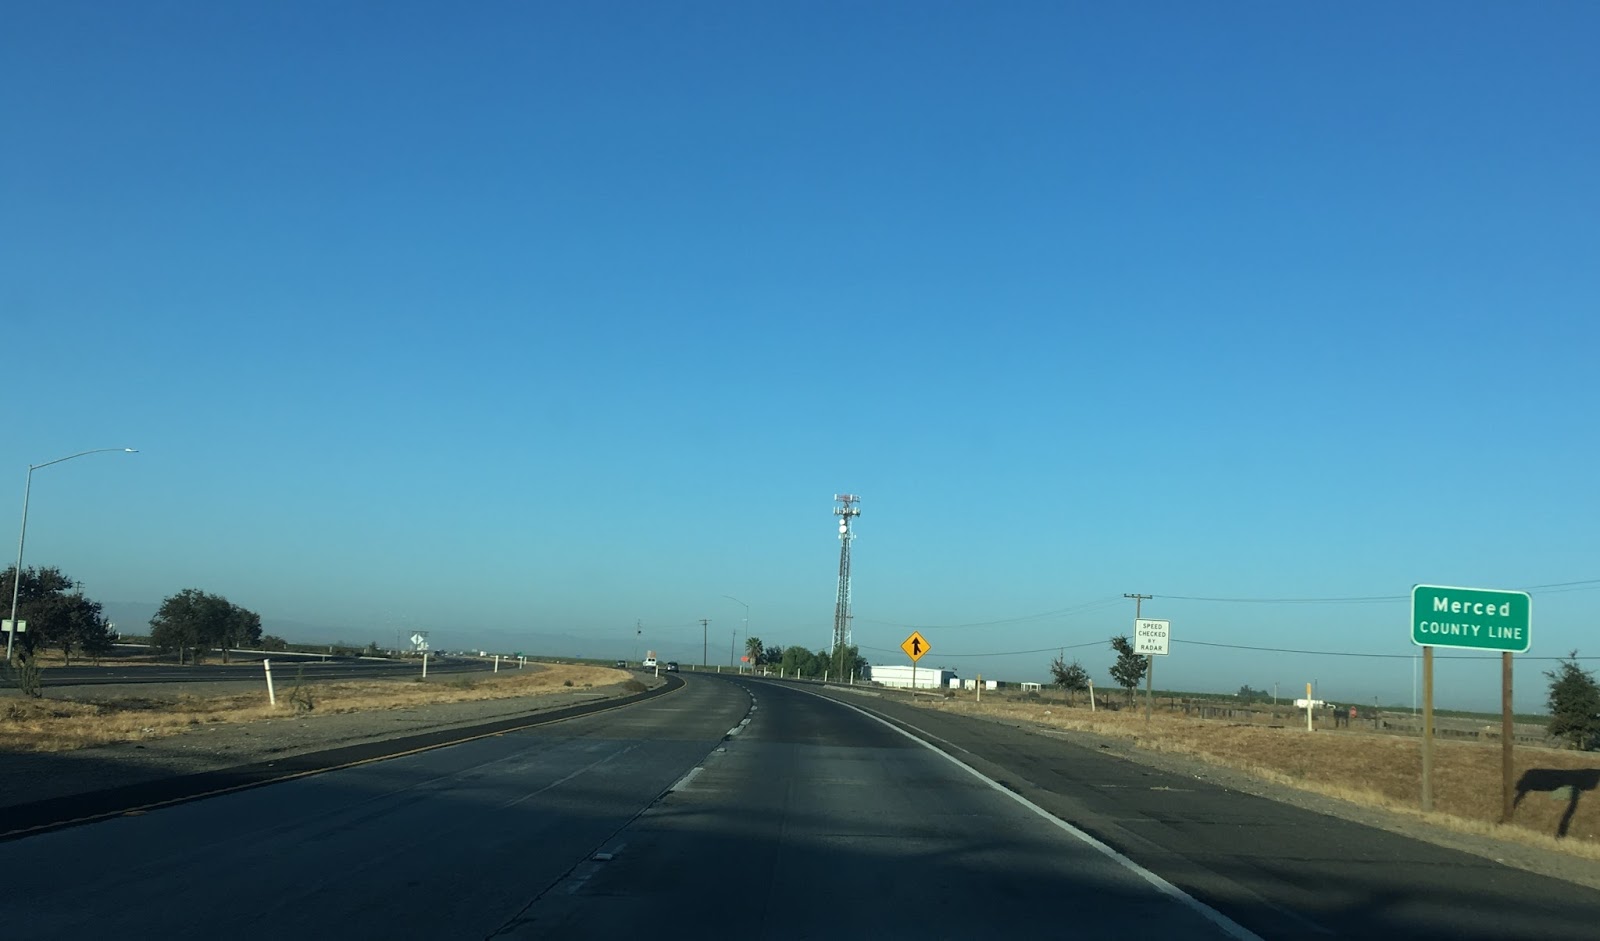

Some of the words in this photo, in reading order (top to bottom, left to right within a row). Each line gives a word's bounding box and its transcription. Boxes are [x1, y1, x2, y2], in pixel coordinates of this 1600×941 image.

[1433, 596, 1511, 617] Merced
[1420, 621, 1481, 637] COUNTY
[1488, 626, 1522, 640] LINE
